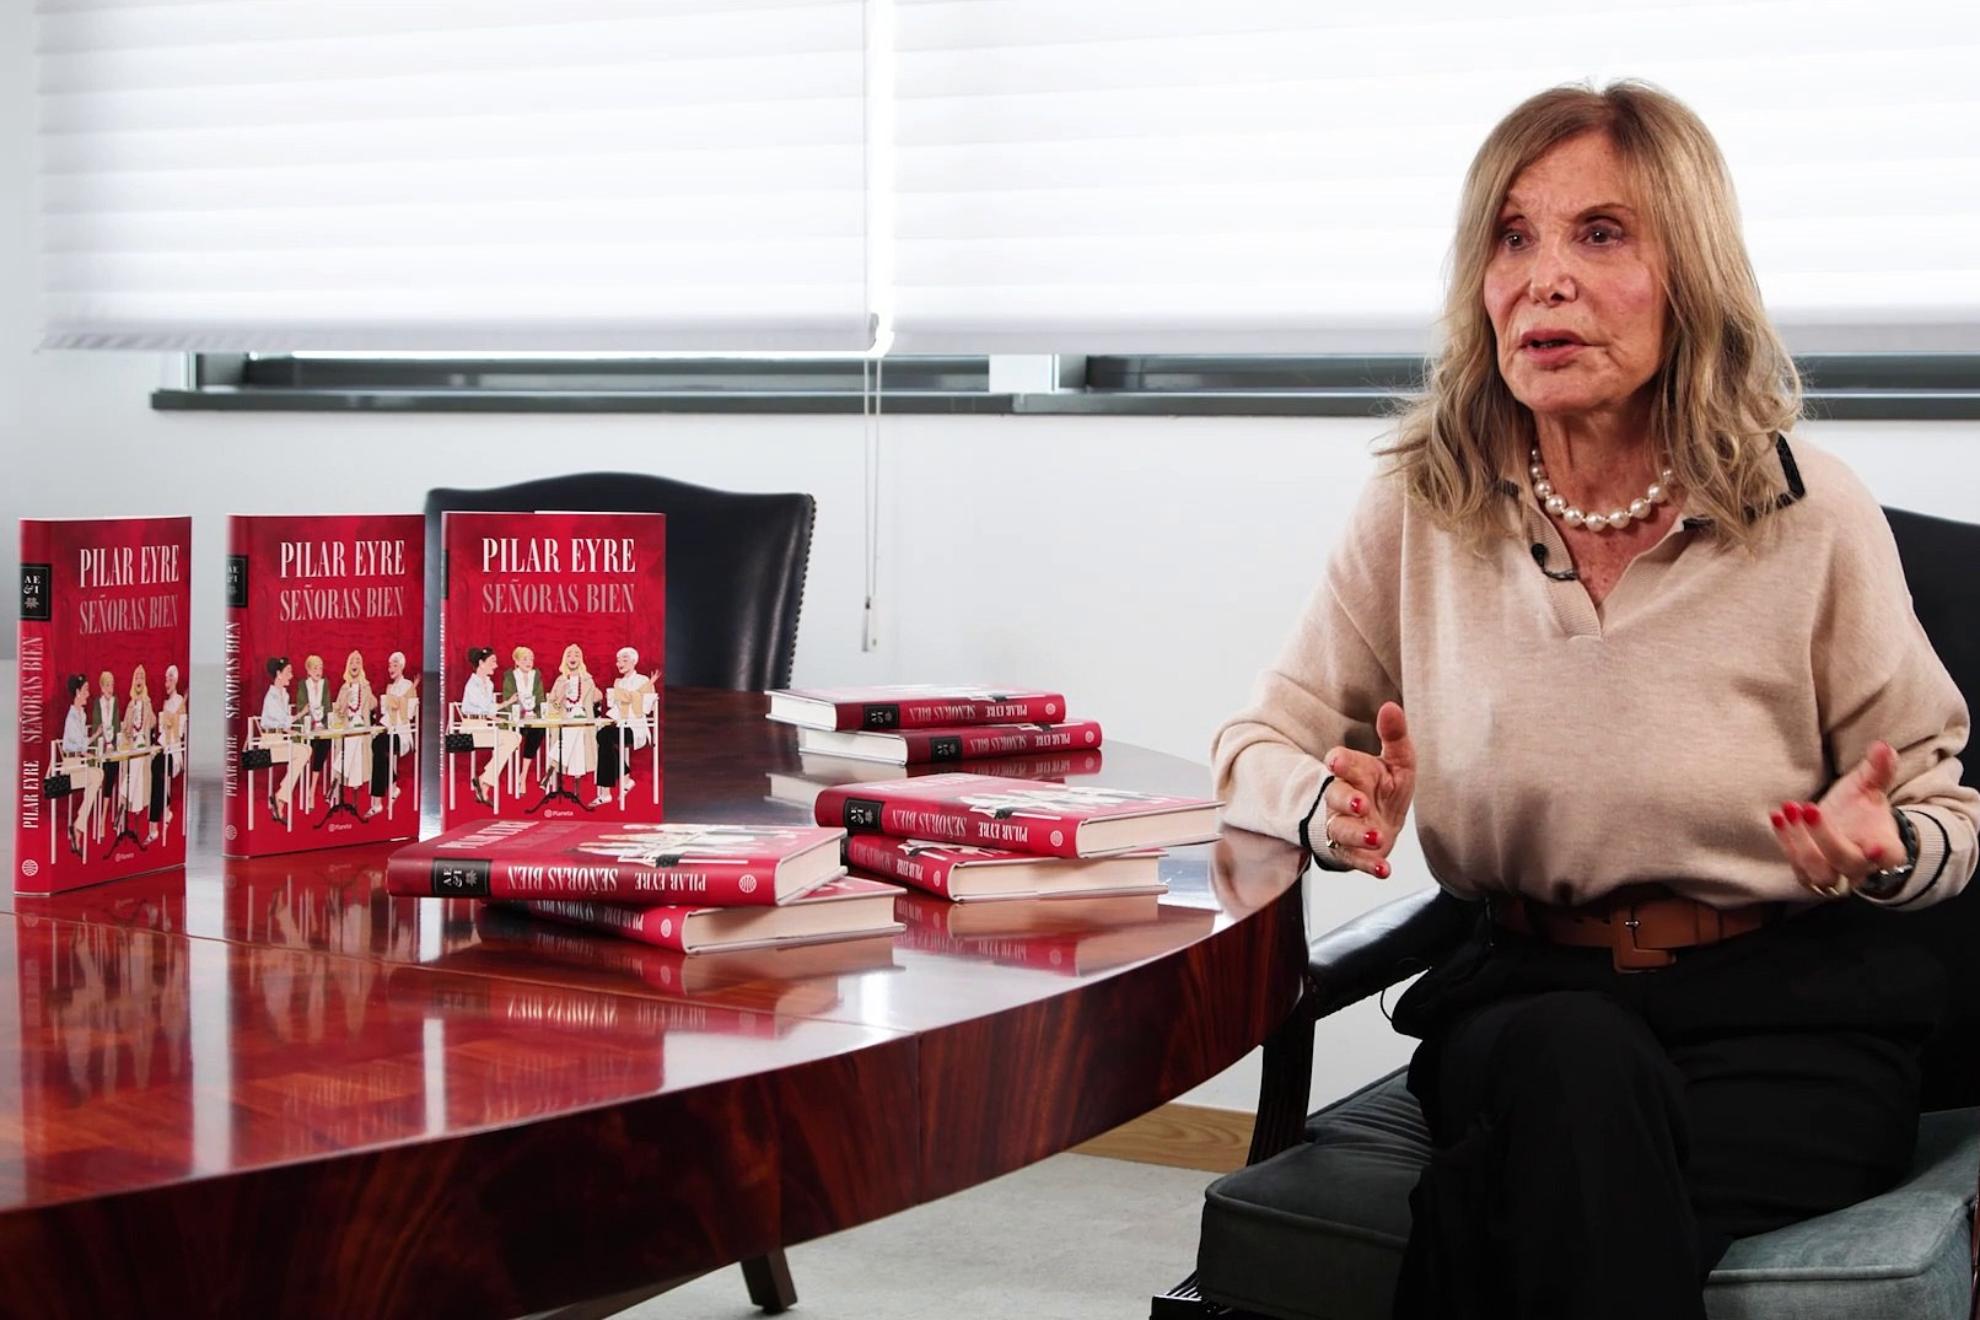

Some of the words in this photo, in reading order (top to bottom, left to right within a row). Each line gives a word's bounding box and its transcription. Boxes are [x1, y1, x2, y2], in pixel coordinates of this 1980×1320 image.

[79, 547, 134, 588] PILAR
[140, 545, 180, 584] EYRE
[280, 541, 346, 578] PILAR
[355, 540, 405, 576] EYRE
[482, 537, 561, 573] PILAR
[570, 538, 636, 573] EYRE
[280, 584, 361, 621] SEÑORAS
[366, 586, 404, 618] BIEN
[482, 579, 579, 613] SEÑORAS
[586, 583, 635, 613] BIEN
[79, 594, 146, 635] SEÑORAS
[150, 594, 178, 629] BIEN
[22, 636, 43, 671] BIEN
[226, 621, 241, 653] BIEN
[19, 676, 43, 744] SEÑORAS
[23, 760, 39, 791] EYRE
[22, 794, 39, 829] PILAR
[892, 809, 917, 828] BIEN
[978, 821, 1001, 839] EYRE
[1002, 825, 1028, 842] PILAR
[507, 865, 543, 890] BIEN
[548, 866, 619, 895] SEÑORAS
[634, 872, 667, 890] EYRE
[670, 873, 706, 891] PILAR
